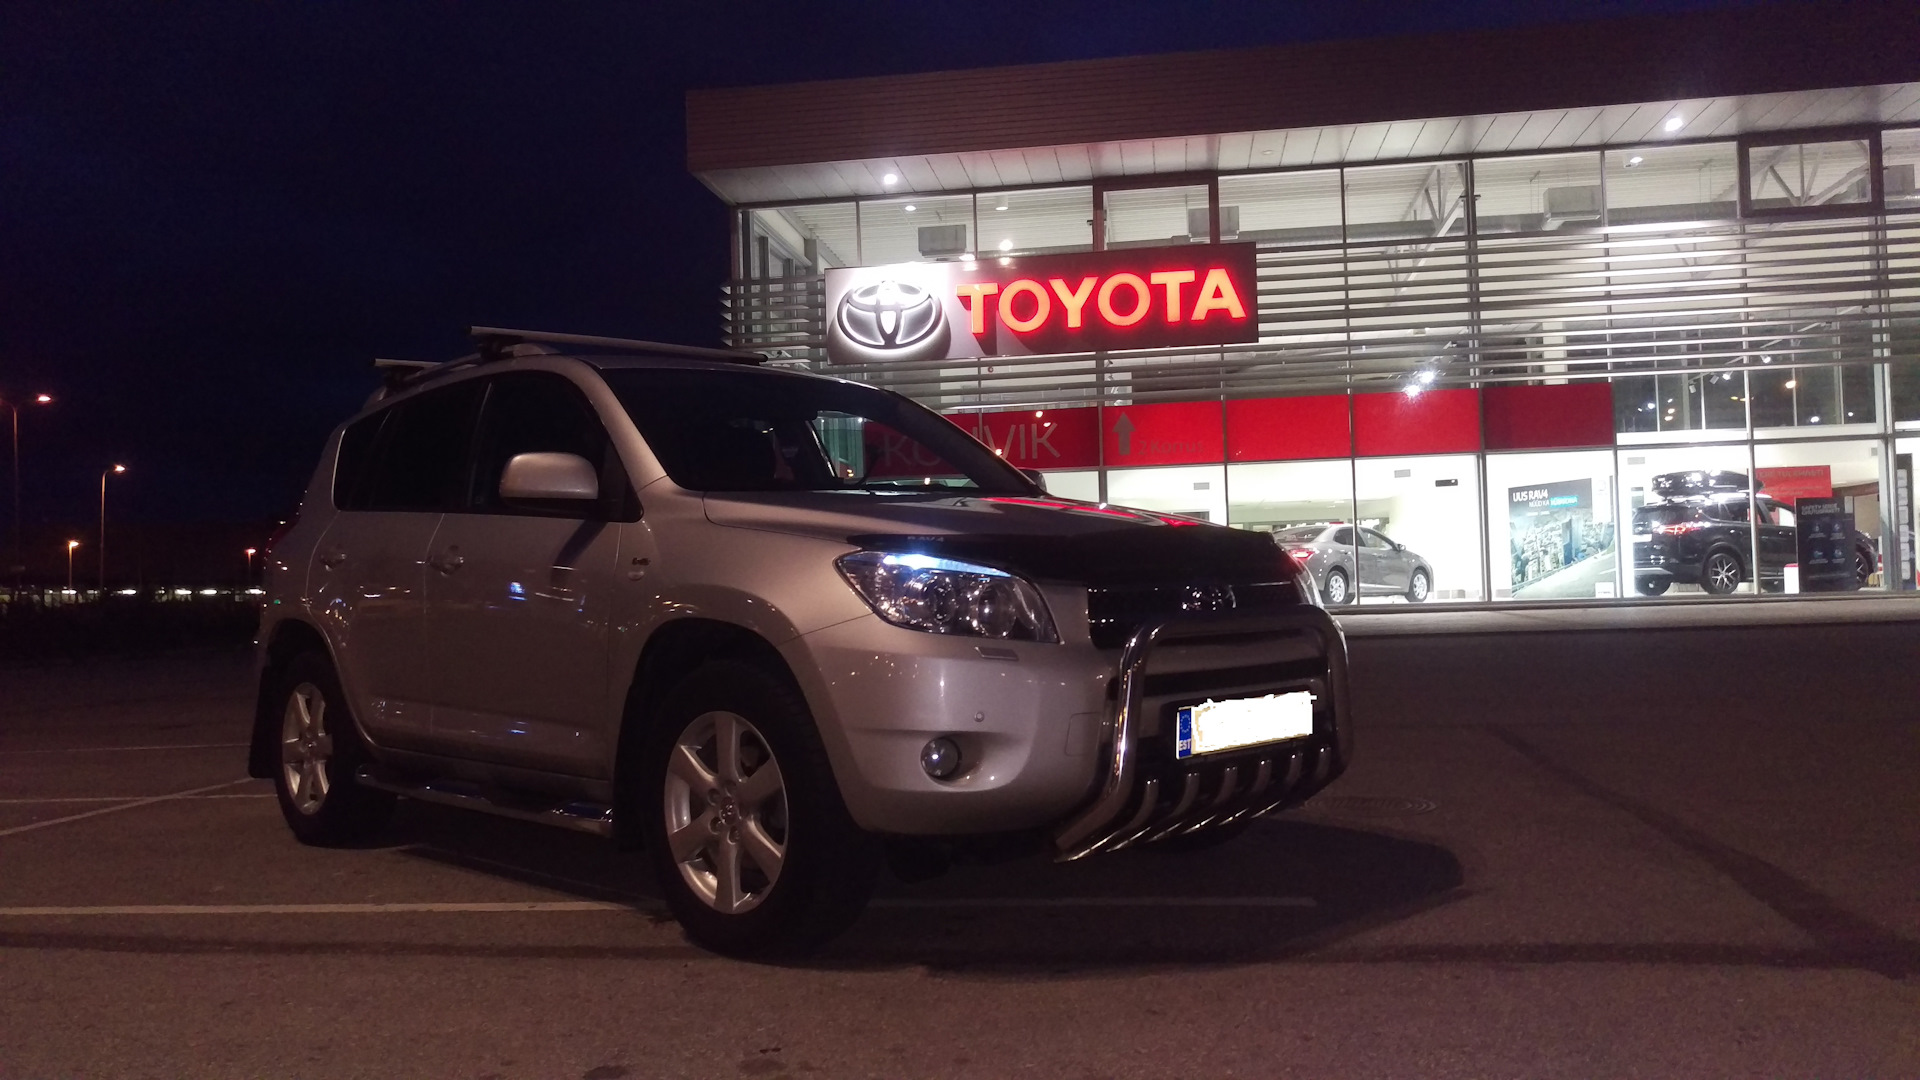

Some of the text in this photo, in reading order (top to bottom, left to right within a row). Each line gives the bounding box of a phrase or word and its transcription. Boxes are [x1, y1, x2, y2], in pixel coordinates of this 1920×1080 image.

[956, 268, 1247, 334] TOYOTA
[1138, 440, 1147, 455] 2
[1512, 491, 1528, 502] UUS
[1528, 489, 1548, 501] RAV4
[1179, 738, 1191, 751] EST
